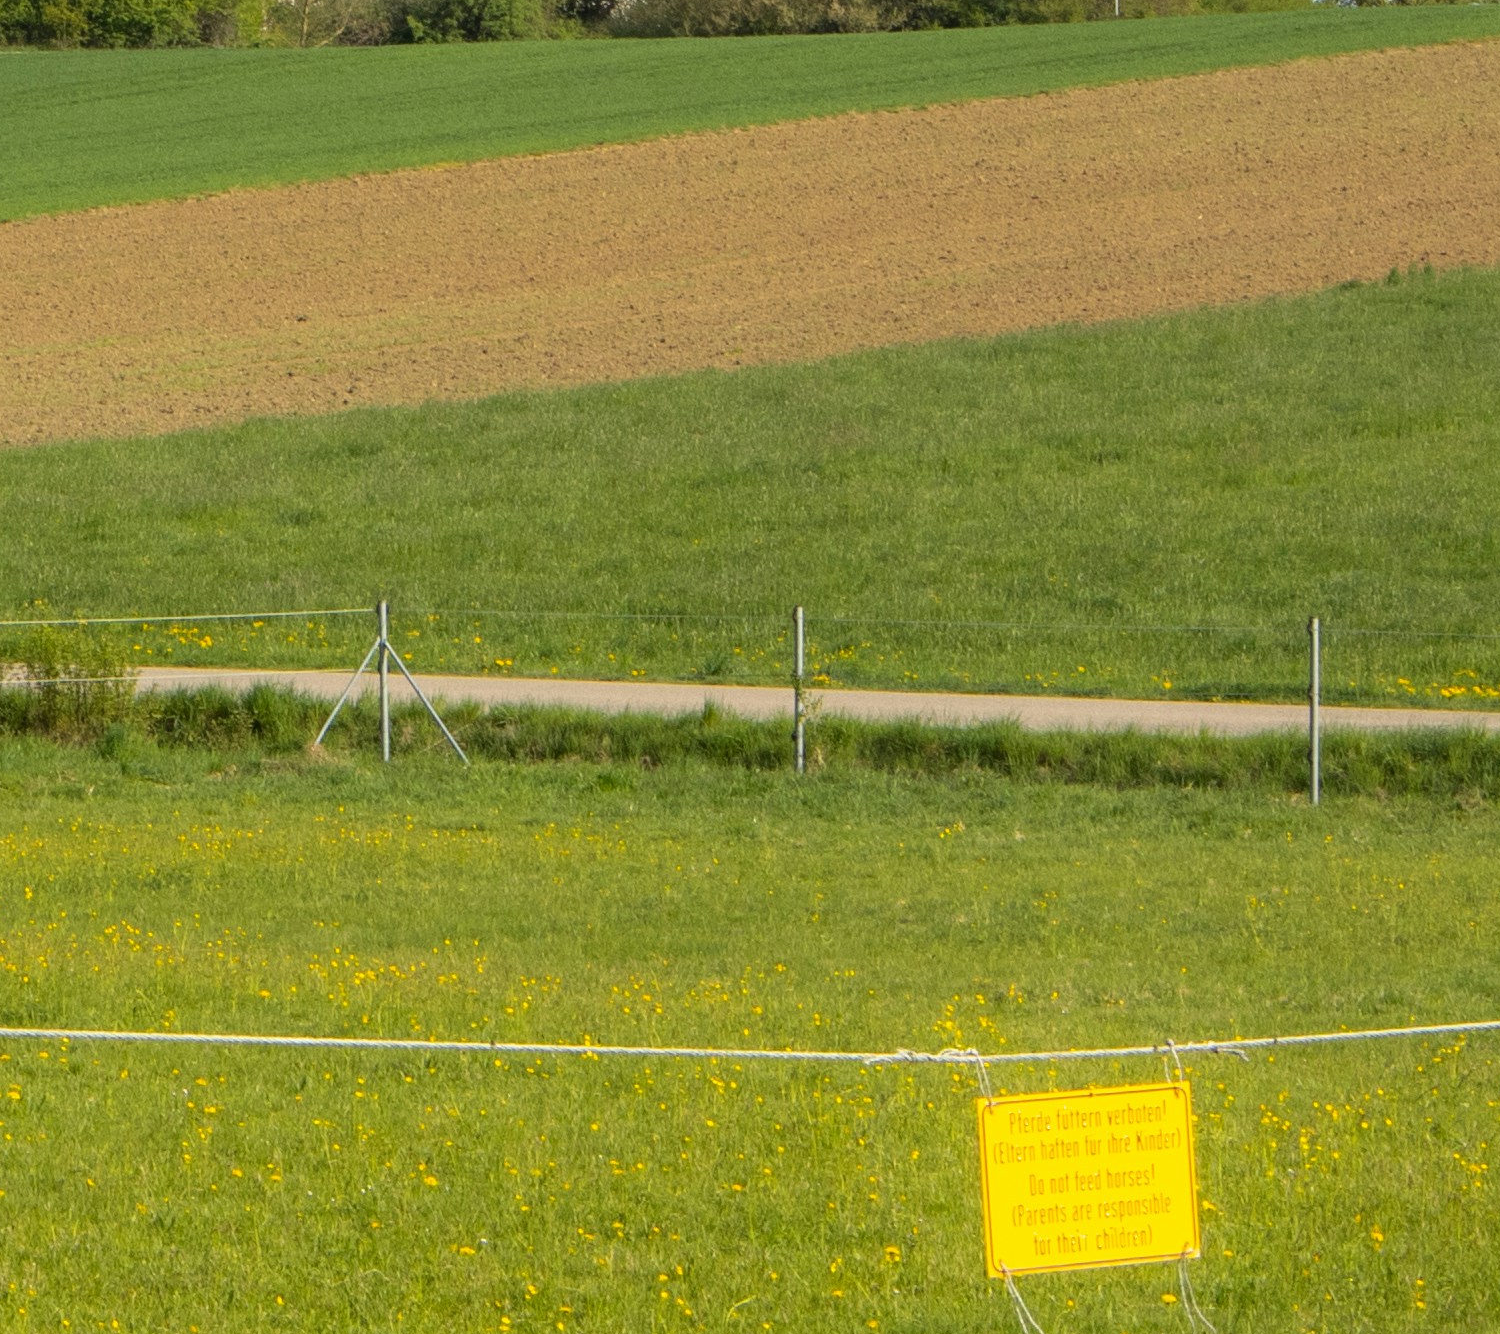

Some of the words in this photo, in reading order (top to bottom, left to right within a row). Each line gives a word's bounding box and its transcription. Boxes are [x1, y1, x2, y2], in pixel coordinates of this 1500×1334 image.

[1009, 1110, 1051, 1134] Pferde
[993, 1141, 1036, 1164] (Eltern
[1040, 1138, 1080, 1161] haften
[1107, 1132, 1131, 1155] ihre
[1135, 1126, 1182, 1152] Kinder)
[1028, 1173, 1045, 1196] Do
[1049, 1172, 1070, 1195] not
[1074, 1168, 1103, 1192] feed
[1106, 1162, 1155, 1189] horses!
[1011, 1203, 1068, 1227] (Parents
[1072, 1202, 1093, 1222] are
[1097, 1191, 1172, 1222] responsible
[1033, 1233, 1052, 1256] for
[1056, 1228, 1089, 1254] their
[1095, 1223, 1154, 1250] children)
